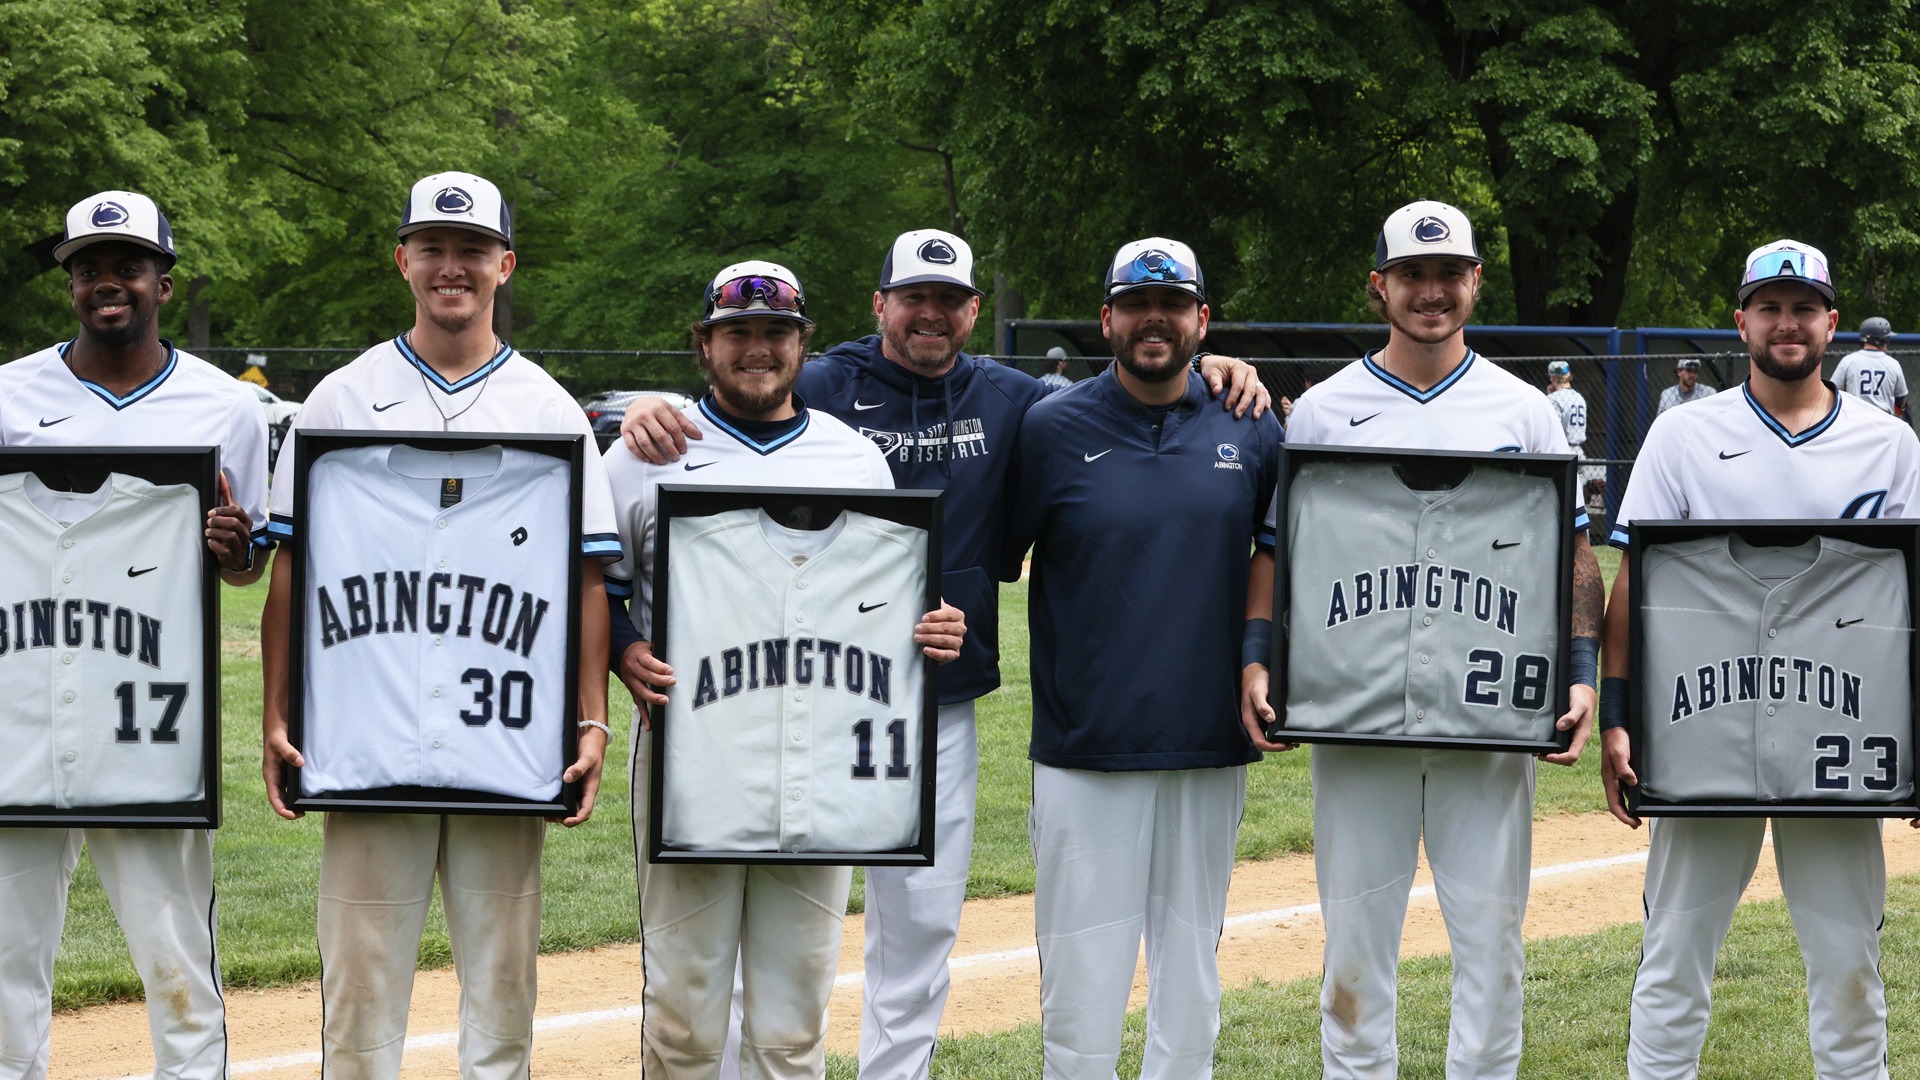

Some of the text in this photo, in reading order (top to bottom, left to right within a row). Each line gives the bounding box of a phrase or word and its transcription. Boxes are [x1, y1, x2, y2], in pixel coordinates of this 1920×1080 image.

[1860, 369, 1886, 396] 27
[926, 422, 949, 439] STAT
[1570, 404, 1585, 427] 25
[899, 439, 988, 463] BASEALL
[1214, 461, 1243, 471] ABINGTON
[317, 570, 550, 659] ABINGTON
[1325, 562, 1520, 638] ABINGTON
[459, 667, 534, 730] 30
[692, 636, 893, 711] ABINGTON
[1462, 647, 1551, 712] 28
[1669, 654, 1863, 725] ABINGTON
[114, 680, 190, 744] 17
[851, 718, 912, 780] 11
[1812, 732, 1900, 793] 23
